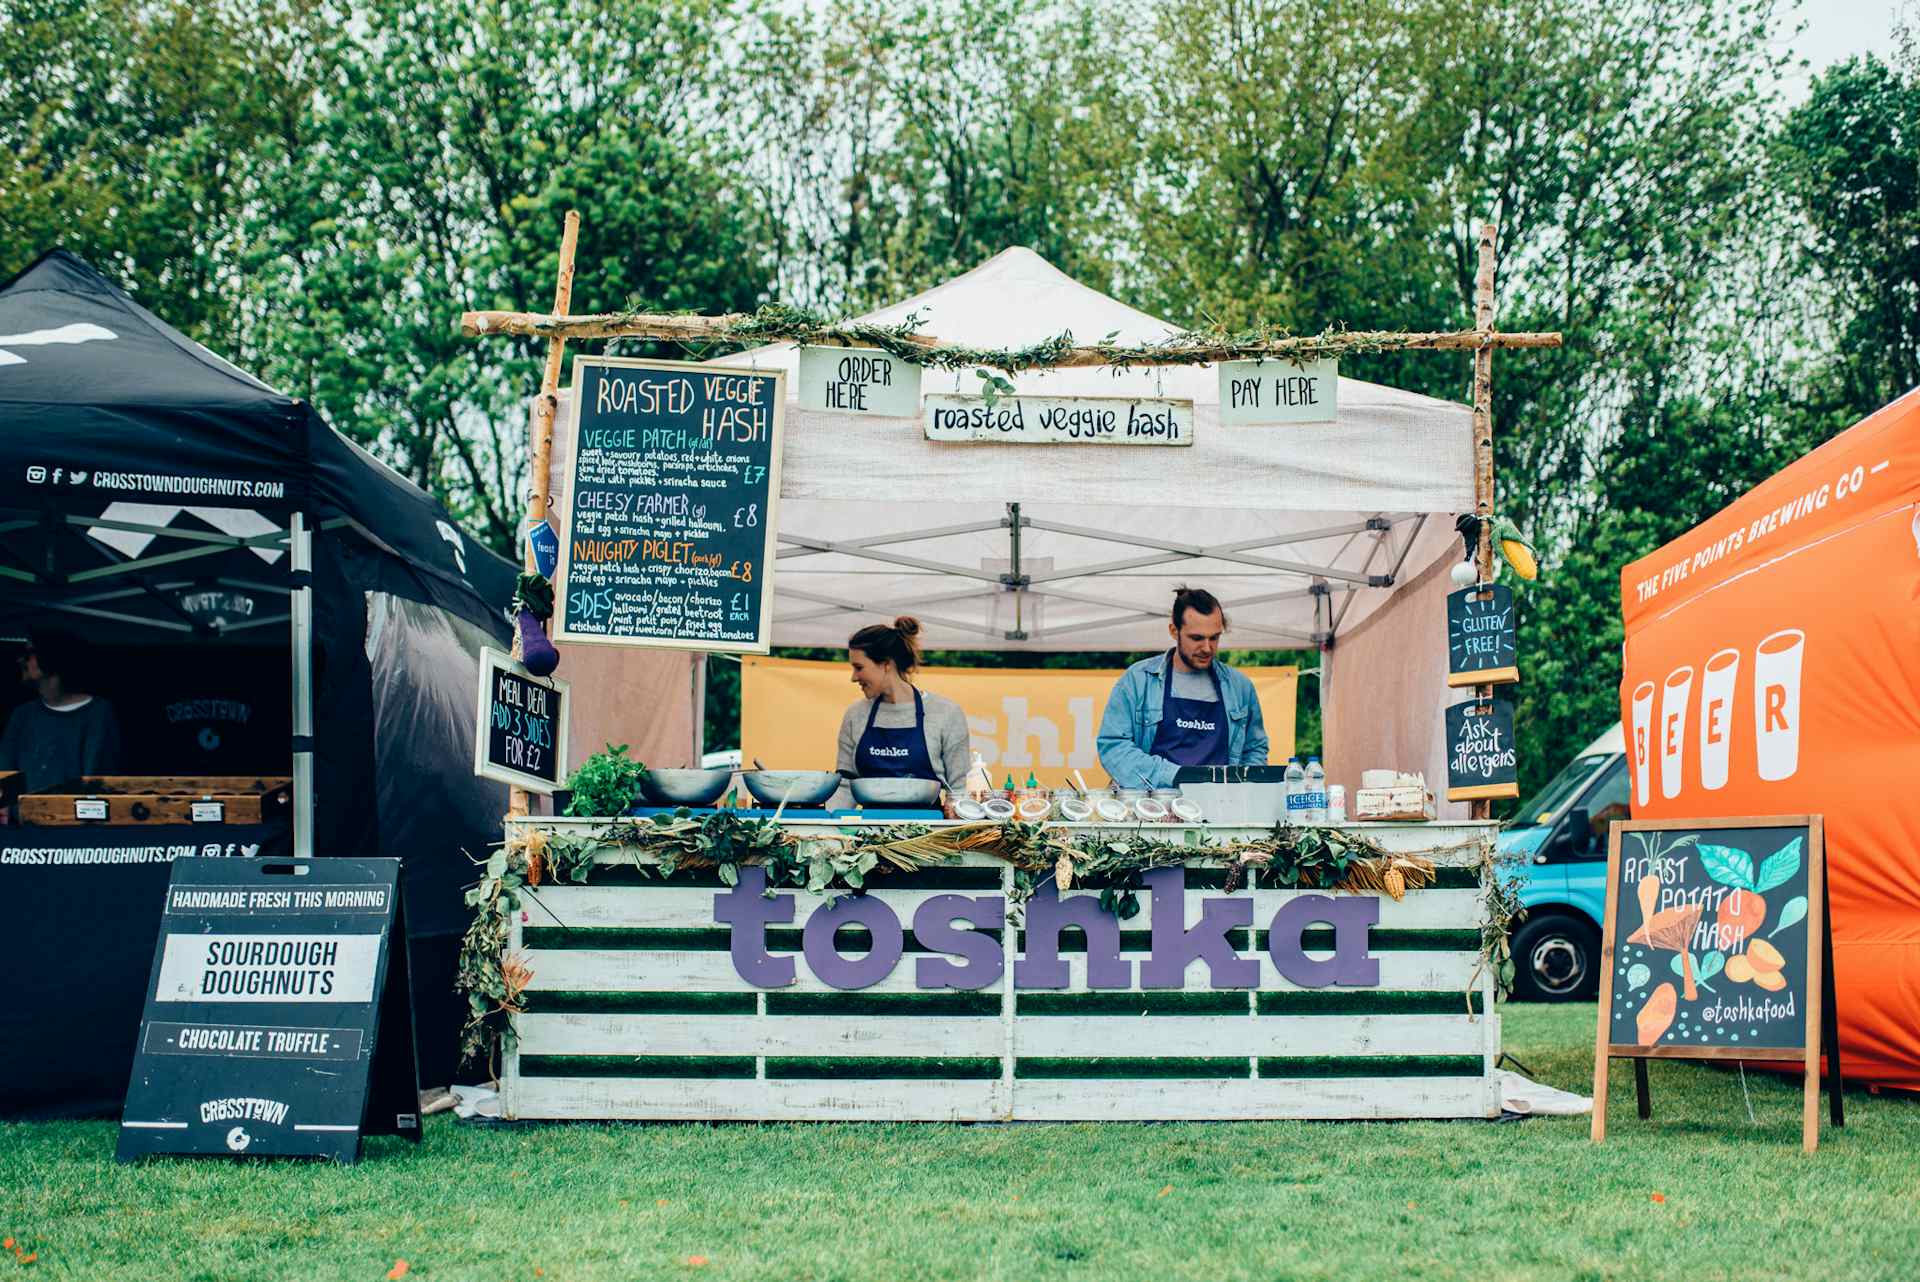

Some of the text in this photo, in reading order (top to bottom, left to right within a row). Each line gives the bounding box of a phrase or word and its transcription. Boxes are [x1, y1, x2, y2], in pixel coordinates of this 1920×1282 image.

[839, 357, 891, 386] ORDER
[597, 376, 765, 415] ROASTED VEGGIE
[826, 381, 868, 410] HERE
[1231, 377, 1318, 408] PAY HERE
[702, 407, 766, 442] HASH
[934, 405, 1179, 438] roasted veggie hash
[584, 429, 635, 448] VEGGIE
[643, 429, 686, 449] PATCH
[726, 455, 750, 463] onions
[93, 471, 284, 499] CROSSTOWNDOUGHNUTS.COM
[578, 473, 605, 483] Served
[608, 475, 625, 484] with
[629, 476, 656, 487] pickles
[701, 479, 727, 487] sauce
[744, 465, 766, 484] £7
[577, 491, 634, 511] CHEESY
[636, 493, 689, 515] FARMER
[733, 503, 757, 527] £8
[577, 511, 602, 523] veggie
[605, 512, 628, 525] patch
[632, 512, 653, 524] hash
[576, 521, 594, 534] fried
[598, 525, 611, 537] egg
[653, 530, 672, 541] mayo
[683, 529, 709, 540] pickles
[1637, 466, 1865, 603] THE FIVE POINTS BREWING CO
[573, 539, 639, 562] NAUGHTY
[642, 539, 695, 564] PIGLET
[570, 572, 591, 583] fried
[592, 576, 606, 586] egg
[615, 574, 652, 584] sriracha
[655, 577, 677, 587] mayo
[688, 576, 718, 588] pickles
[574, 563, 598, 574] veggie
[600, 562, 621, 574] patch
[623, 563, 640, 573] hash
[648, 565, 672, 576] crispy
[731, 561, 752, 582] £8
[569, 588, 613, 618] SIDES
[612, 602, 648, 614] halloumi
[684, 605, 723, 620] beetroot
[730, 592, 749, 611] £1
[636, 614, 657, 627] petit
[685, 619, 706, 630] fried
[707, 622, 722, 632] egg
[730, 612, 749, 621] EACH
[1463, 614, 1506, 633] GLUTEN
[569, 620, 606, 632] artichoke
[720, 630, 754, 640] tomatoes
[1465, 635, 1500, 655] FREE!
[499, 677, 550, 719] MEAL DEAL
[491, 700, 551, 749] ADD 3 SIDES
[1176, 718, 1216, 732] toshka
[1459, 718, 1496, 740] Ask
[505, 735, 541, 770] FOR £2
[869, 746, 909, 757] toshka
[1455, 729, 1503, 753] about
[1450, 750, 1516, 778] allergens
[1, 845, 197, 865] CROSSTOWNDOUGHNUTS.COM
[1624, 857, 1688, 884] ROAST
[172, 890, 385, 908] HANDMADE FRESH THIS MORNING
[1660, 885, 1742, 916] POTATO
[714, 866, 1380, 990] toshka
[1693, 921, 1744, 955] HASH
[206, 942, 337, 966] SOURDOUGH
[202, 970, 335, 994] DOUGHNUTS
[1702, 992, 1795, 1024] @toshkafood
[179, 1028, 329, 1053] CHOCOLATE TRUFFLE
[200, 1097, 289, 1125] CROSSTOWN
